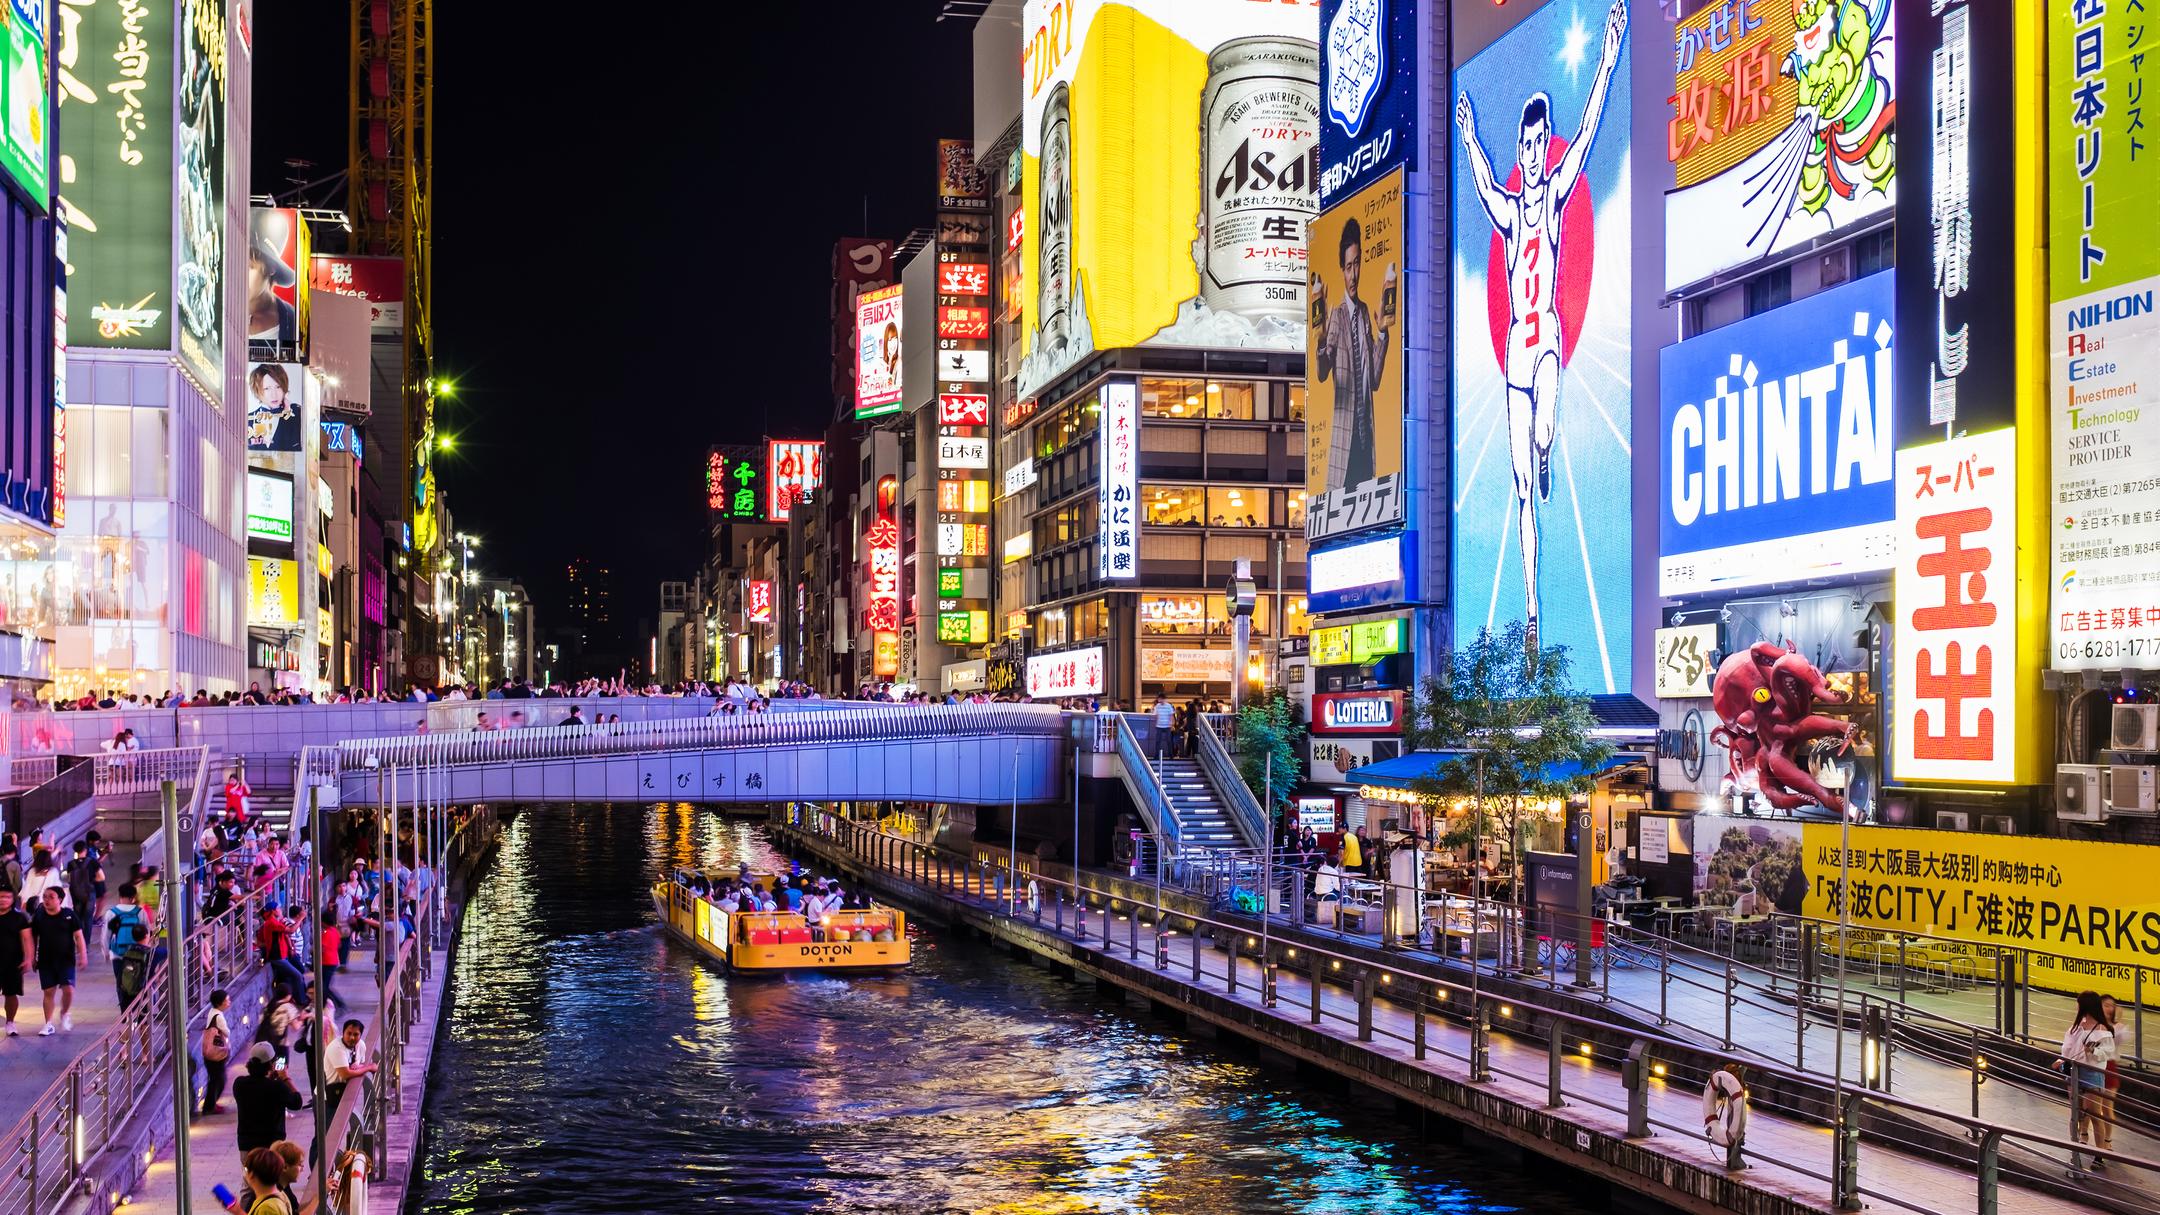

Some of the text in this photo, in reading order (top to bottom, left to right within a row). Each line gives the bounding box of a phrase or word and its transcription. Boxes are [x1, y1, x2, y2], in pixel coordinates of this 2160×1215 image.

[1675, 0, 1764, 75] かぜに
[1229, 101, 1252, 124] ASAHI
[1253, 91, 1302, 106] BREWERIES
[1665, 36, 1774, 164] 改源
[1319, 128, 1393, 198] 雪印メグミルク
[943, 196, 956, 206] 9F
[1363, 184, 1401, 219] リラックスが
[1262, 216, 1300, 241] 生
[941, 253, 958, 263] 8F
[1264, 262, 1297, 273] 生ビール
[1265, 286, 1297, 301] 350ml
[1522, 228, 1542, 349] グリコ
[941, 296, 957, 306] 7F
[2068, 290, 2153, 332] NIHON
[863, 302, 895, 326] 高収入
[940, 321, 988, 336] ダイニング
[940, 339, 958, 349] 6F
[2068, 333, 2105, 357] Real
[2068, 358, 2117, 382] Estate
[949, 383, 963, 393] 5F
[2068, 382, 2138, 407] Investment
[941, 398, 987, 422] はや
[2066, 408, 2141, 431] Technology
[940, 426, 958, 436] 4F
[1671, 345, 1894, 527] CHINTAI
[2068, 429, 2121, 450] SERVICE
[942, 442, 984, 459] 白木屋
[1114, 415, 1130, 475] 本場の味
[2069, 444, 2133, 467] PROVIDER
[733, 461, 757, 511] 千房
[940, 470, 957, 479] 3F
[1915, 452, 1995, 500] スーパー
[940, 513, 957, 523] 2F
[1113, 483, 1132, 571] かに道楽
[940, 556, 957, 567] 1F
[2060, 605, 2160, 632] 広告主募集中
[1911, 506, 1998, 760] 玉出
[902, 640, 911, 660] ZERO
[2060, 639, 2160, 659] 06-6281-1717
[1666, 635, 1704, 687] くくる
[1336, 700, 1388, 723] LOTTERIA
[1312, 742, 1341, 762] たこ焼き
[642, 771, 763, 791] えびす橋
[1547, 869, 1573, 881] information
[800, 944, 852, 956] DOTON
[2036, 954, 2055, 969] and
